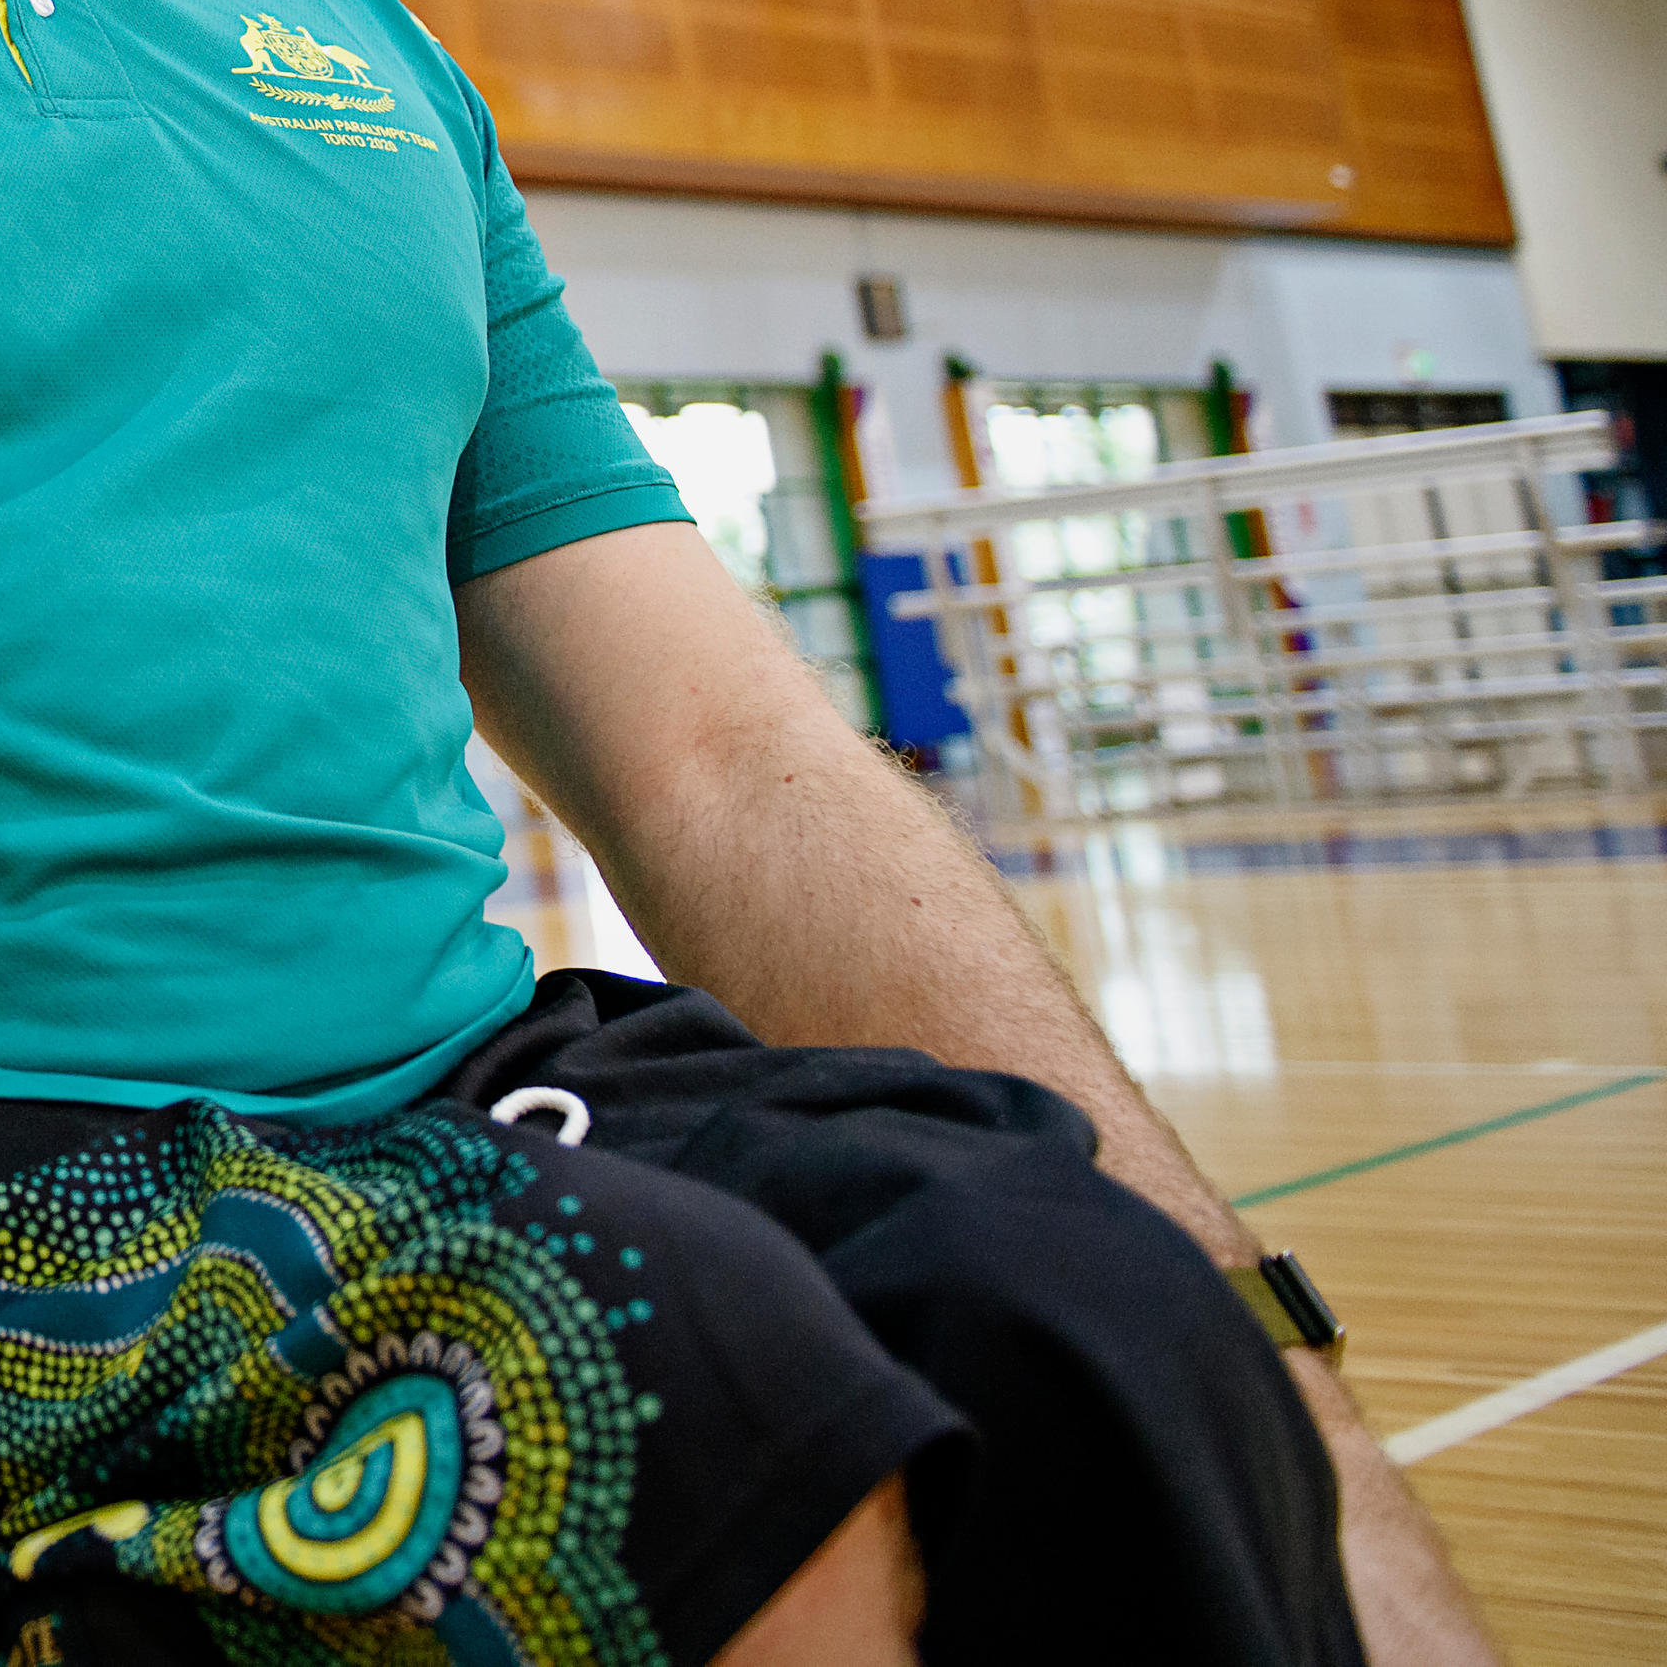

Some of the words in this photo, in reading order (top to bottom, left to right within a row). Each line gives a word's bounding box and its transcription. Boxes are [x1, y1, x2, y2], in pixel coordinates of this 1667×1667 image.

[248, 111, 335, 131] AUSTRALIAN
[334, 119, 409, 143] PARALYMPIC
[407, 131, 439, 152] TEAM
[319, 132, 366, 148] TOKYO
[366, 136, 398, 153] 2020
